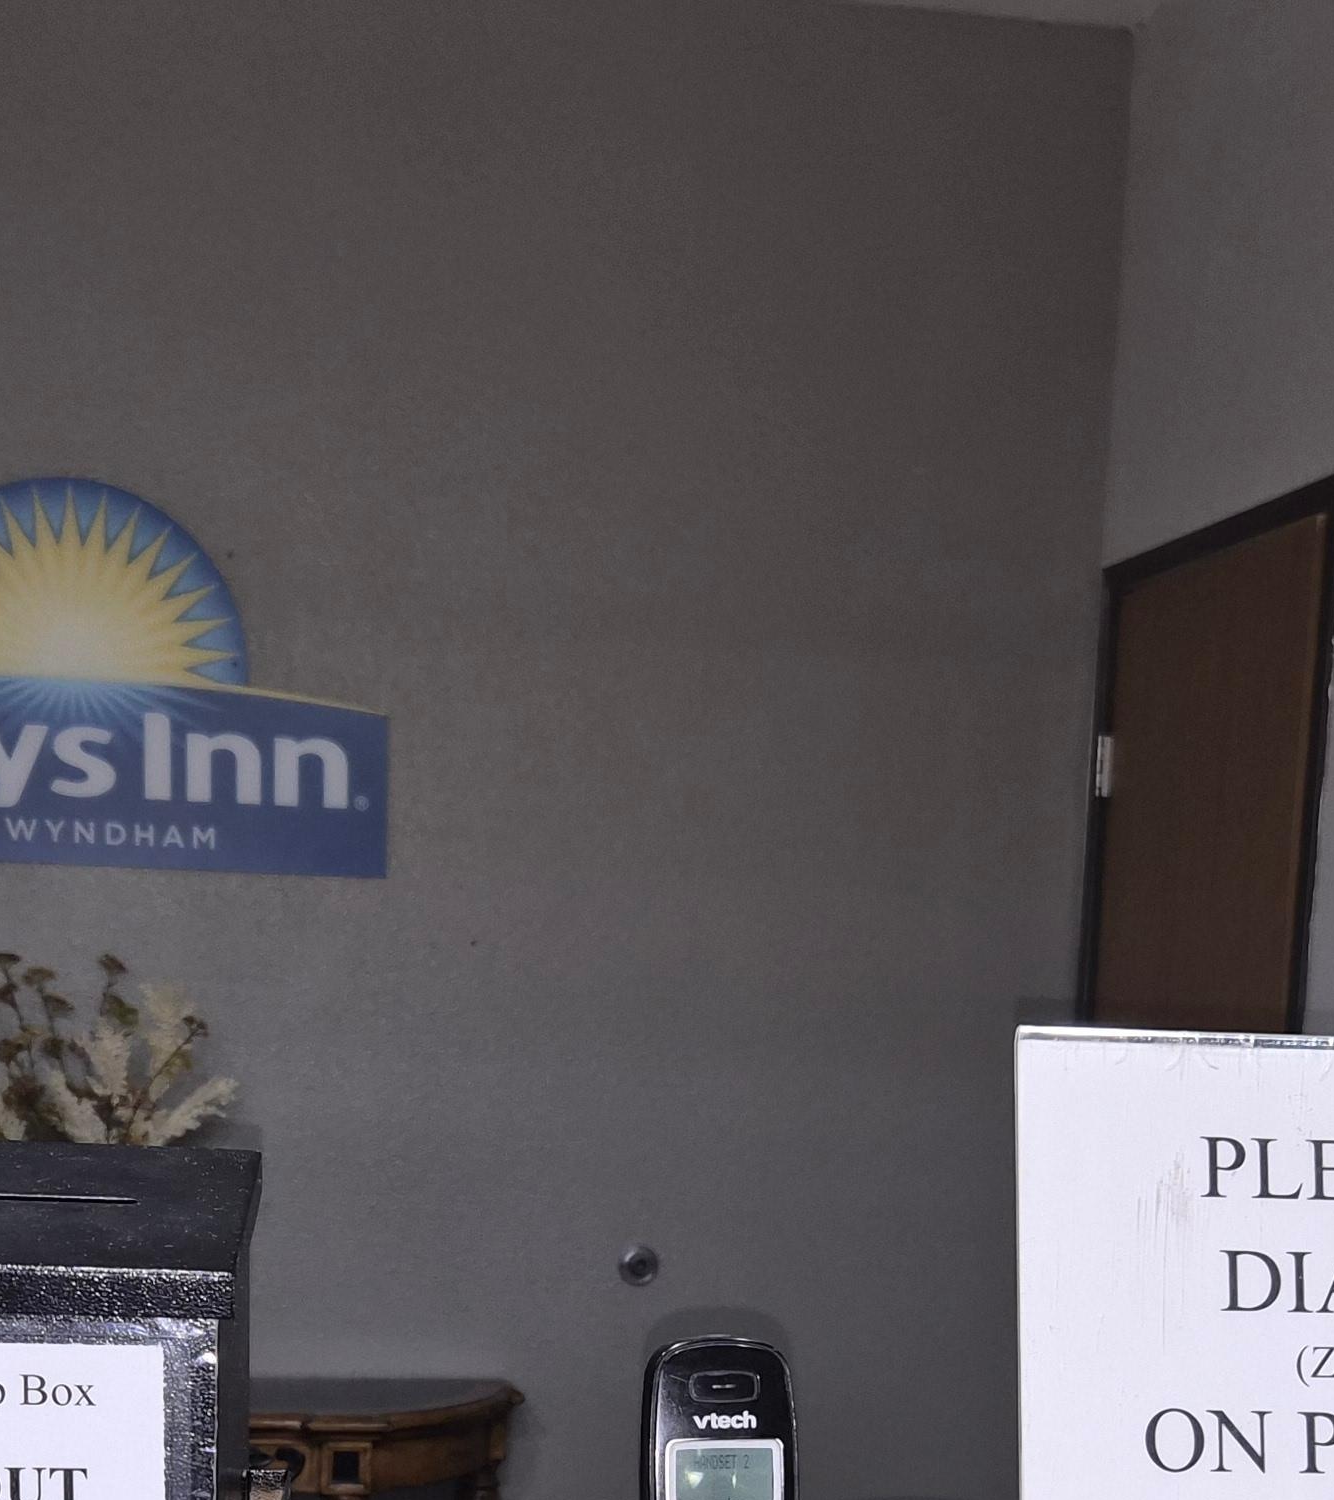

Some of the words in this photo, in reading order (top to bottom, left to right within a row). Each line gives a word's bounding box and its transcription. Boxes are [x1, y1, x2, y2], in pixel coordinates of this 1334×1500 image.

[144, 712, 349, 809] Inn
[7, 817, 217, 850] WYNDHAM
[21, 1375, 95, 1406] Box
[692, 1410, 757, 1430] vtech
[1146, 1408, 1272, 1473] ON
[694, 1454, 738, 1471] HANDSET
[743, 1454, 751, 1470] 2
